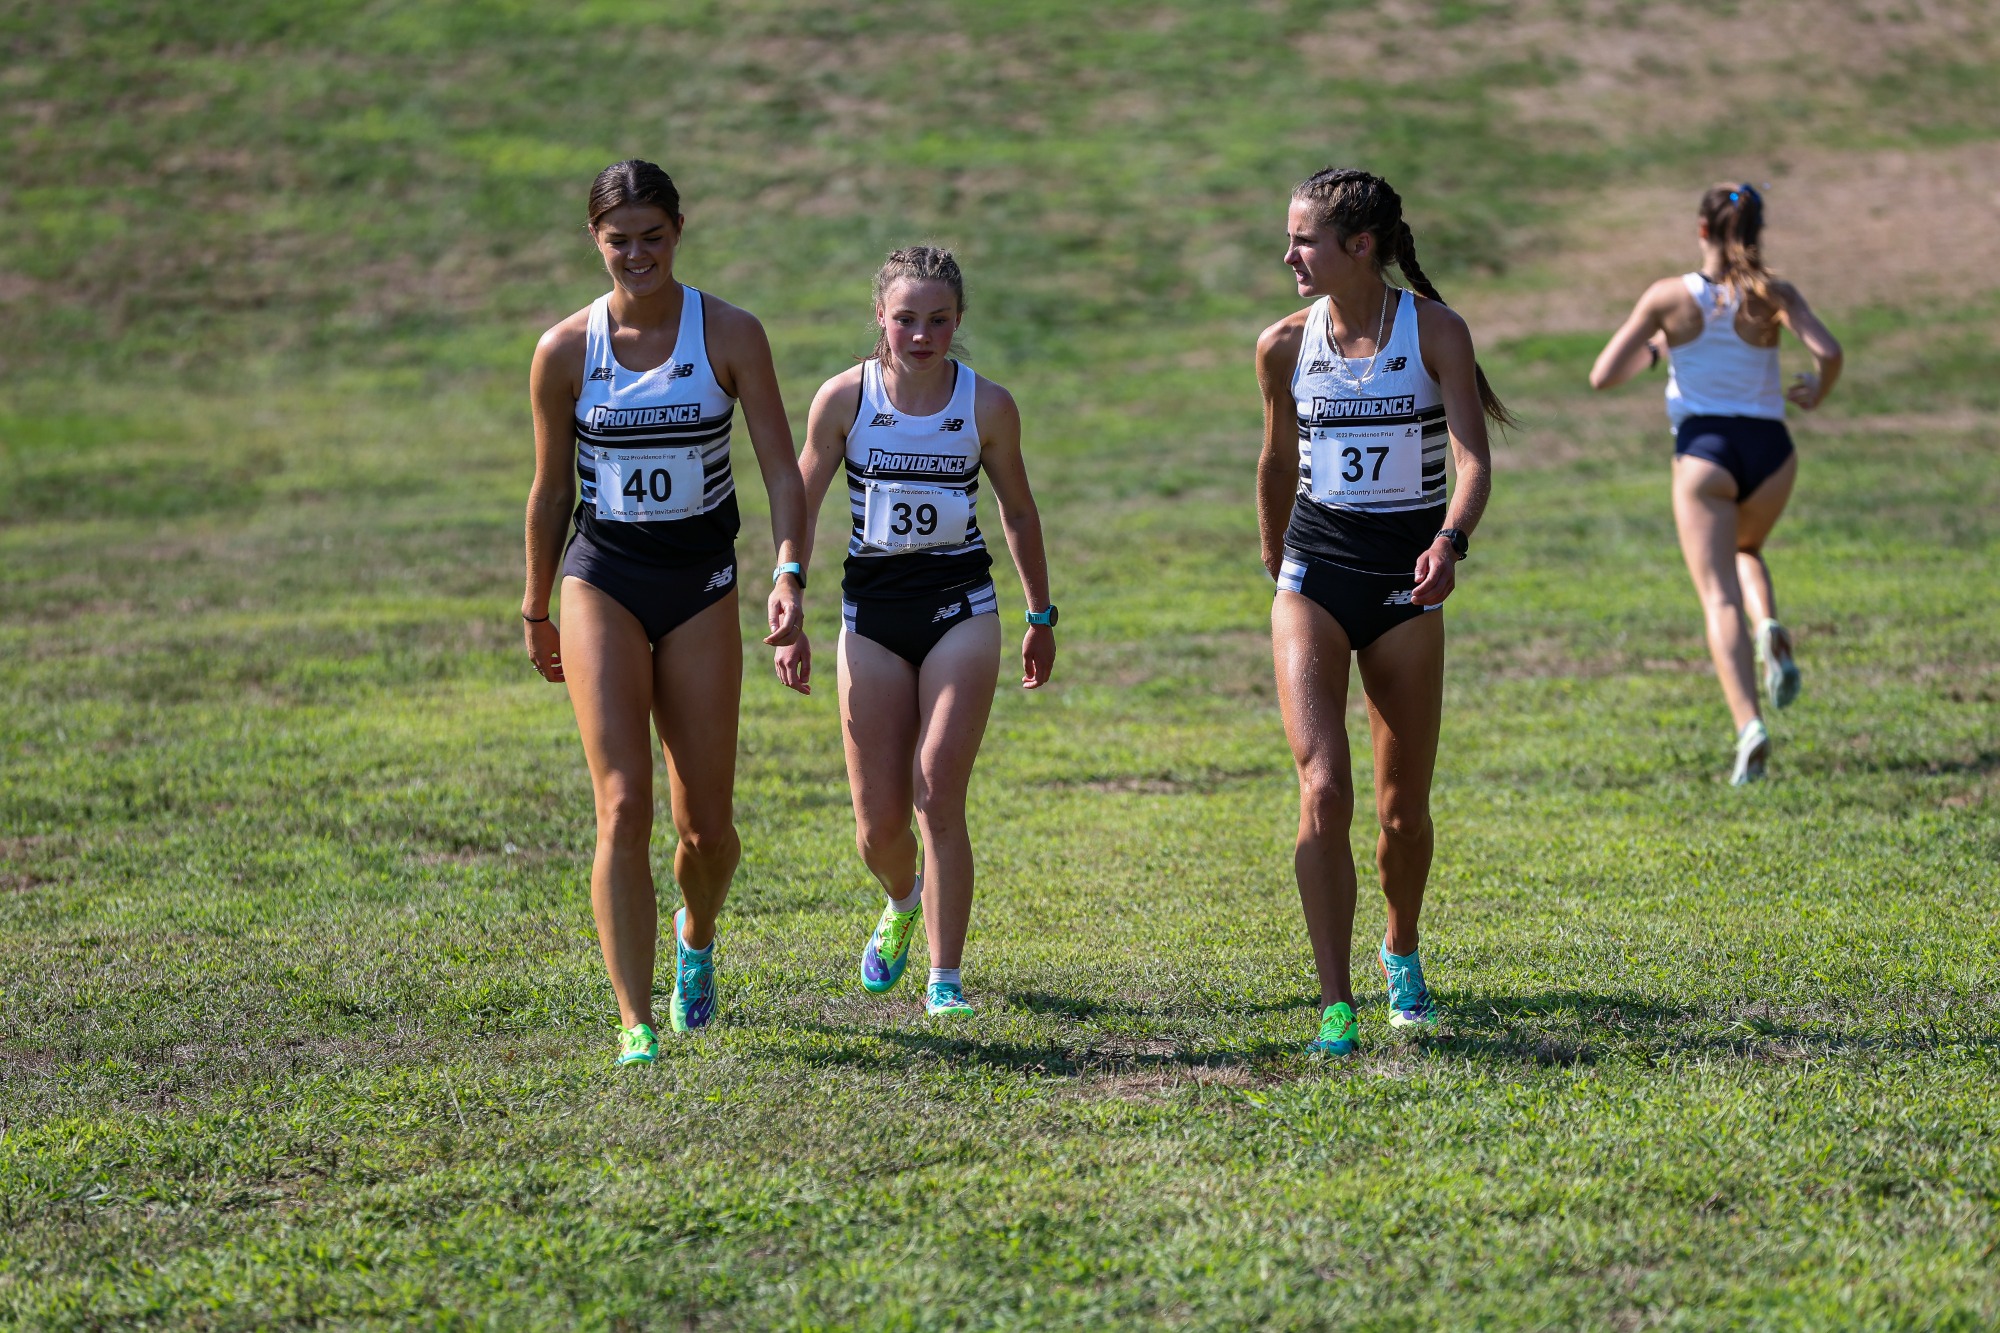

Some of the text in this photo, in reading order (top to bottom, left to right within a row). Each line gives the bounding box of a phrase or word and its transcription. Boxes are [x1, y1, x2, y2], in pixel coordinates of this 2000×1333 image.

[1308, 366, 1336, 374] EAST
[589, 403, 700, 433] PROVIDENCE
[871, 419, 899, 427] EAST
[1310, 394, 1415, 426] PROVIDENCE
[863, 448, 967, 476] PROVIDENCE
[1341, 446, 1389, 483] 37
[623, 468, 672, 503] 40
[1346, 489, 1370, 497] Country
[1372, 487, 1406, 495] Invitational
[612, 507, 688, 517] Cross Country Invitational
[890, 502, 938, 536] 39
[877, 539, 892, 547] Cross
